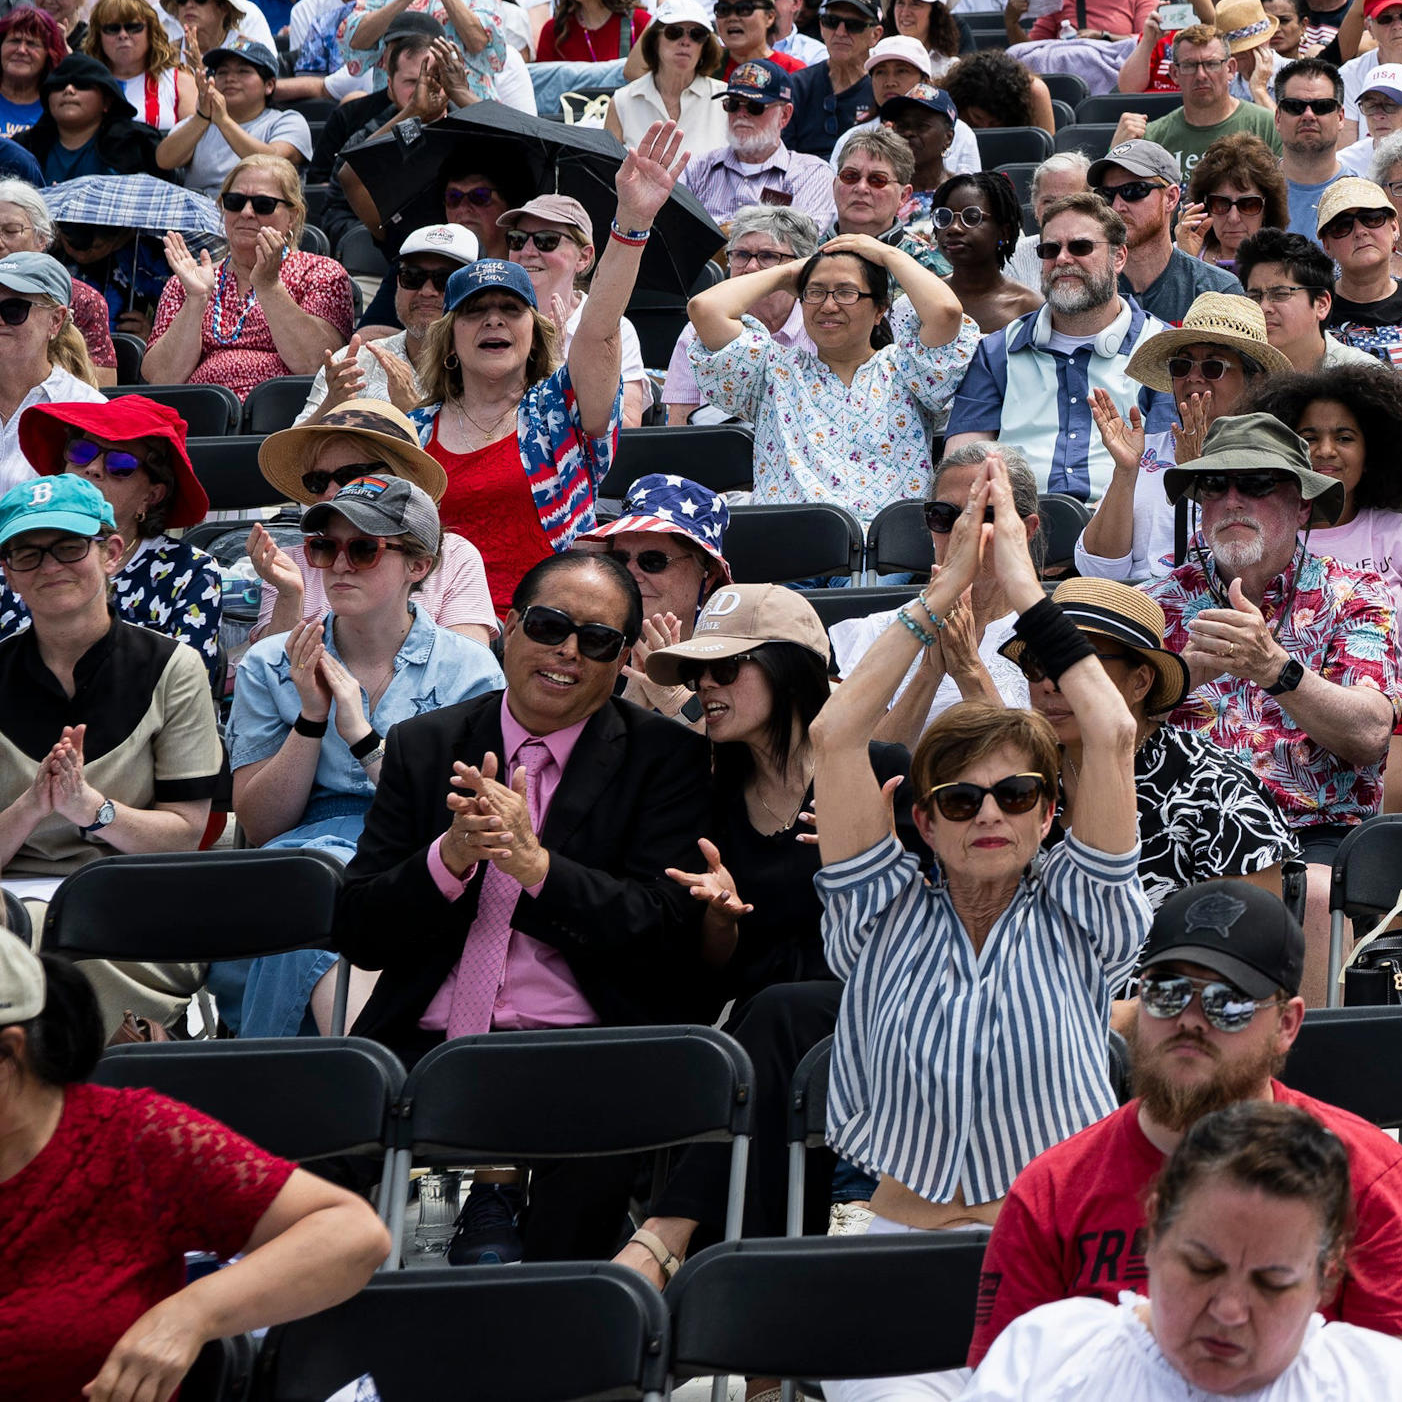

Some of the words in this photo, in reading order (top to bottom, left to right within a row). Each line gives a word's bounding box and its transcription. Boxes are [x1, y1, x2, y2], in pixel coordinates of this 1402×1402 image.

[1373, 71, 1397, 80] USA
[474, 261, 504, 271] Faith
[478, 274, 505, 283] Fear
[29, 482, 53, 506] B
